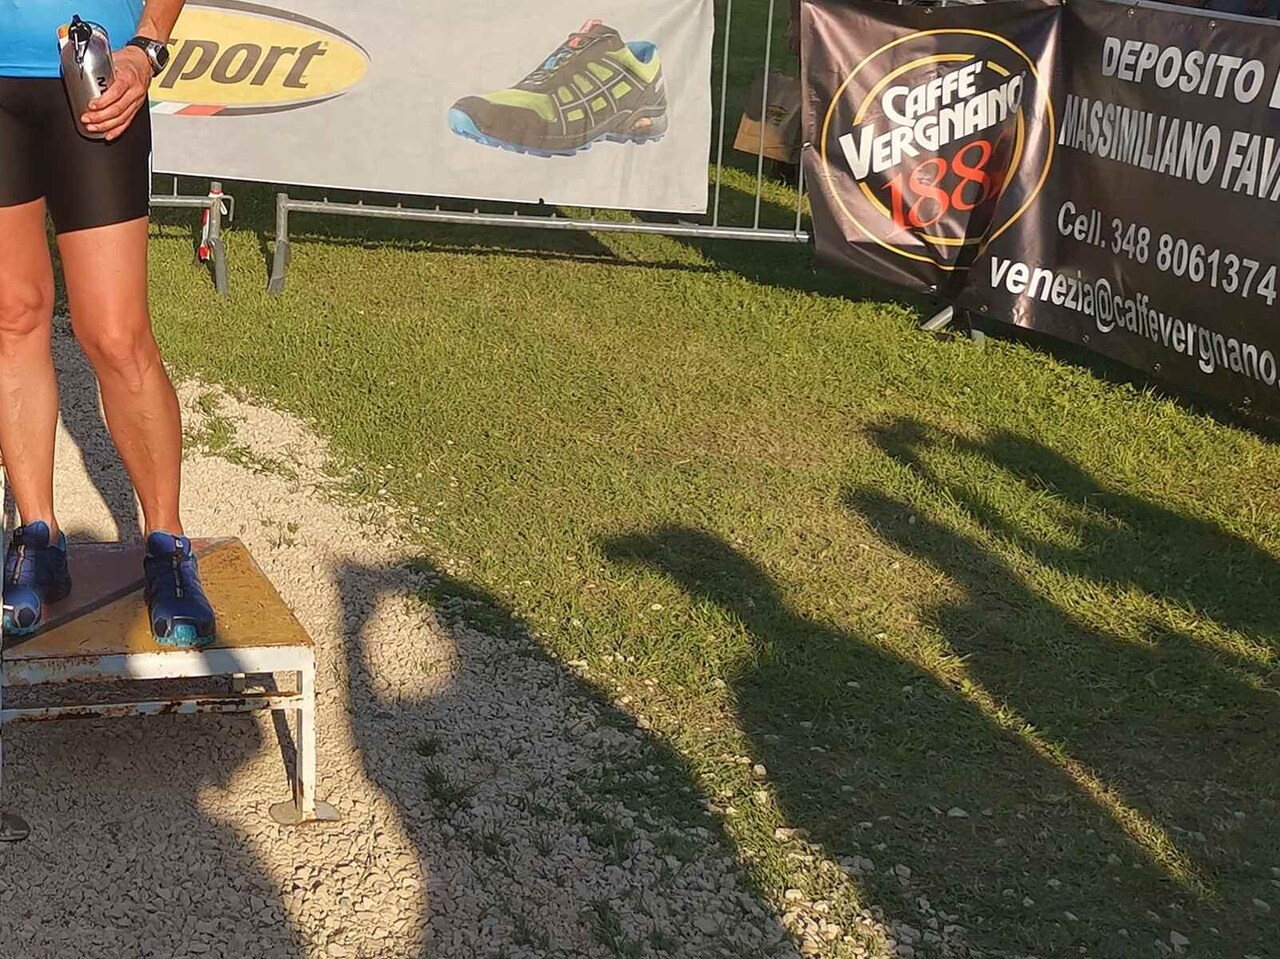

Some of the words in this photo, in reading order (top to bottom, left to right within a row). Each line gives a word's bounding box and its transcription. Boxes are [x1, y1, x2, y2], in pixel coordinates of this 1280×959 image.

[160, 38, 327, 89] port
[1101, 36, 1265, 104] DEPOSITO
[881, 130, 1008, 238] 188
[1057, 93, 1221, 185] MASSIMILIANO
[1057, 200, 1106, 249] Cell.
[1110, 217, 1151, 264] 348
[1156, 233, 1278, 307] 8061374
[989, 256, 1280, 386] venezia@caffevergnano
